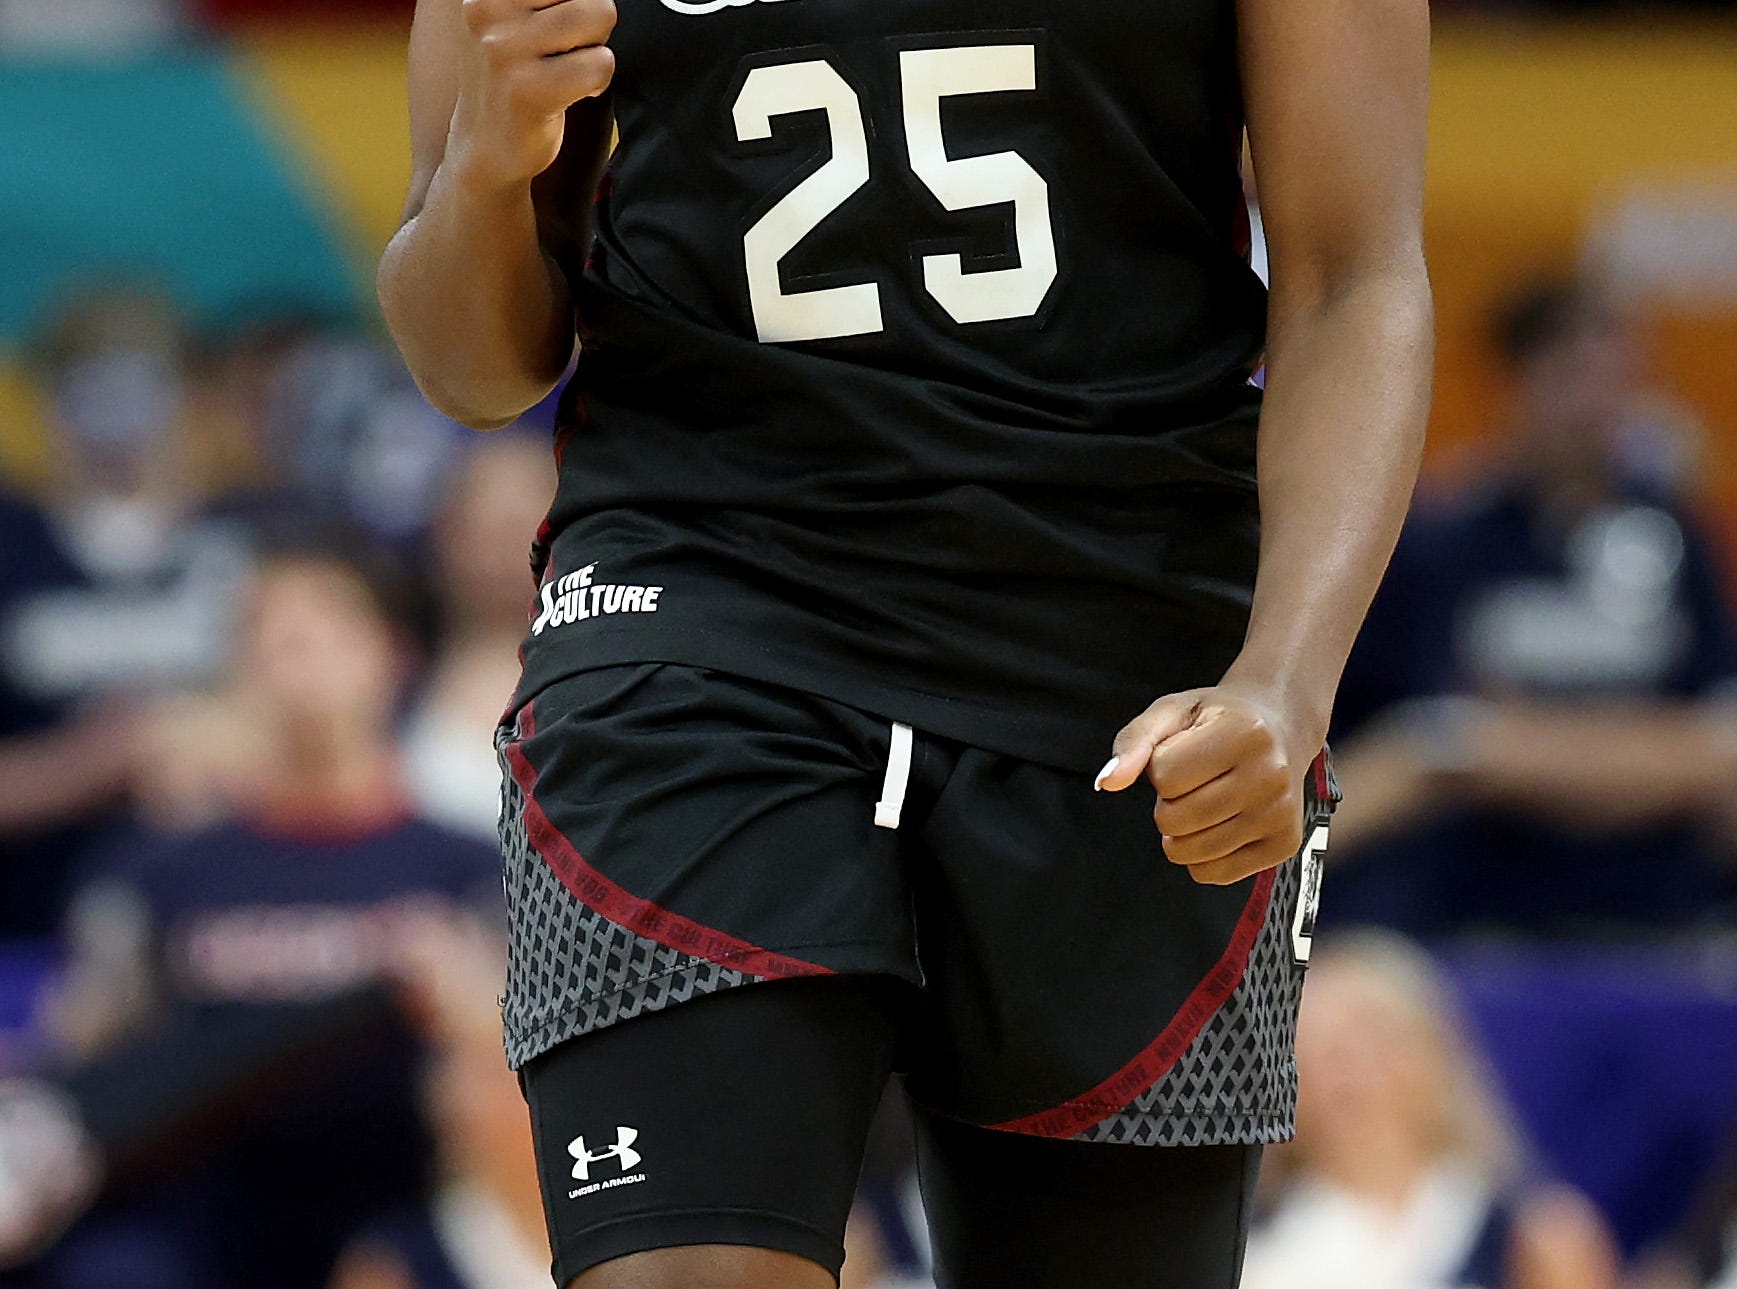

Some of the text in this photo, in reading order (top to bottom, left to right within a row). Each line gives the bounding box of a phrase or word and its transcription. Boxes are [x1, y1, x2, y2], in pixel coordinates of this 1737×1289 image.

[732, 44, 1058, 343] 25
[549, 584, 664, 628] CULTURE
[568, 1183, 600, 1199] UNDER
